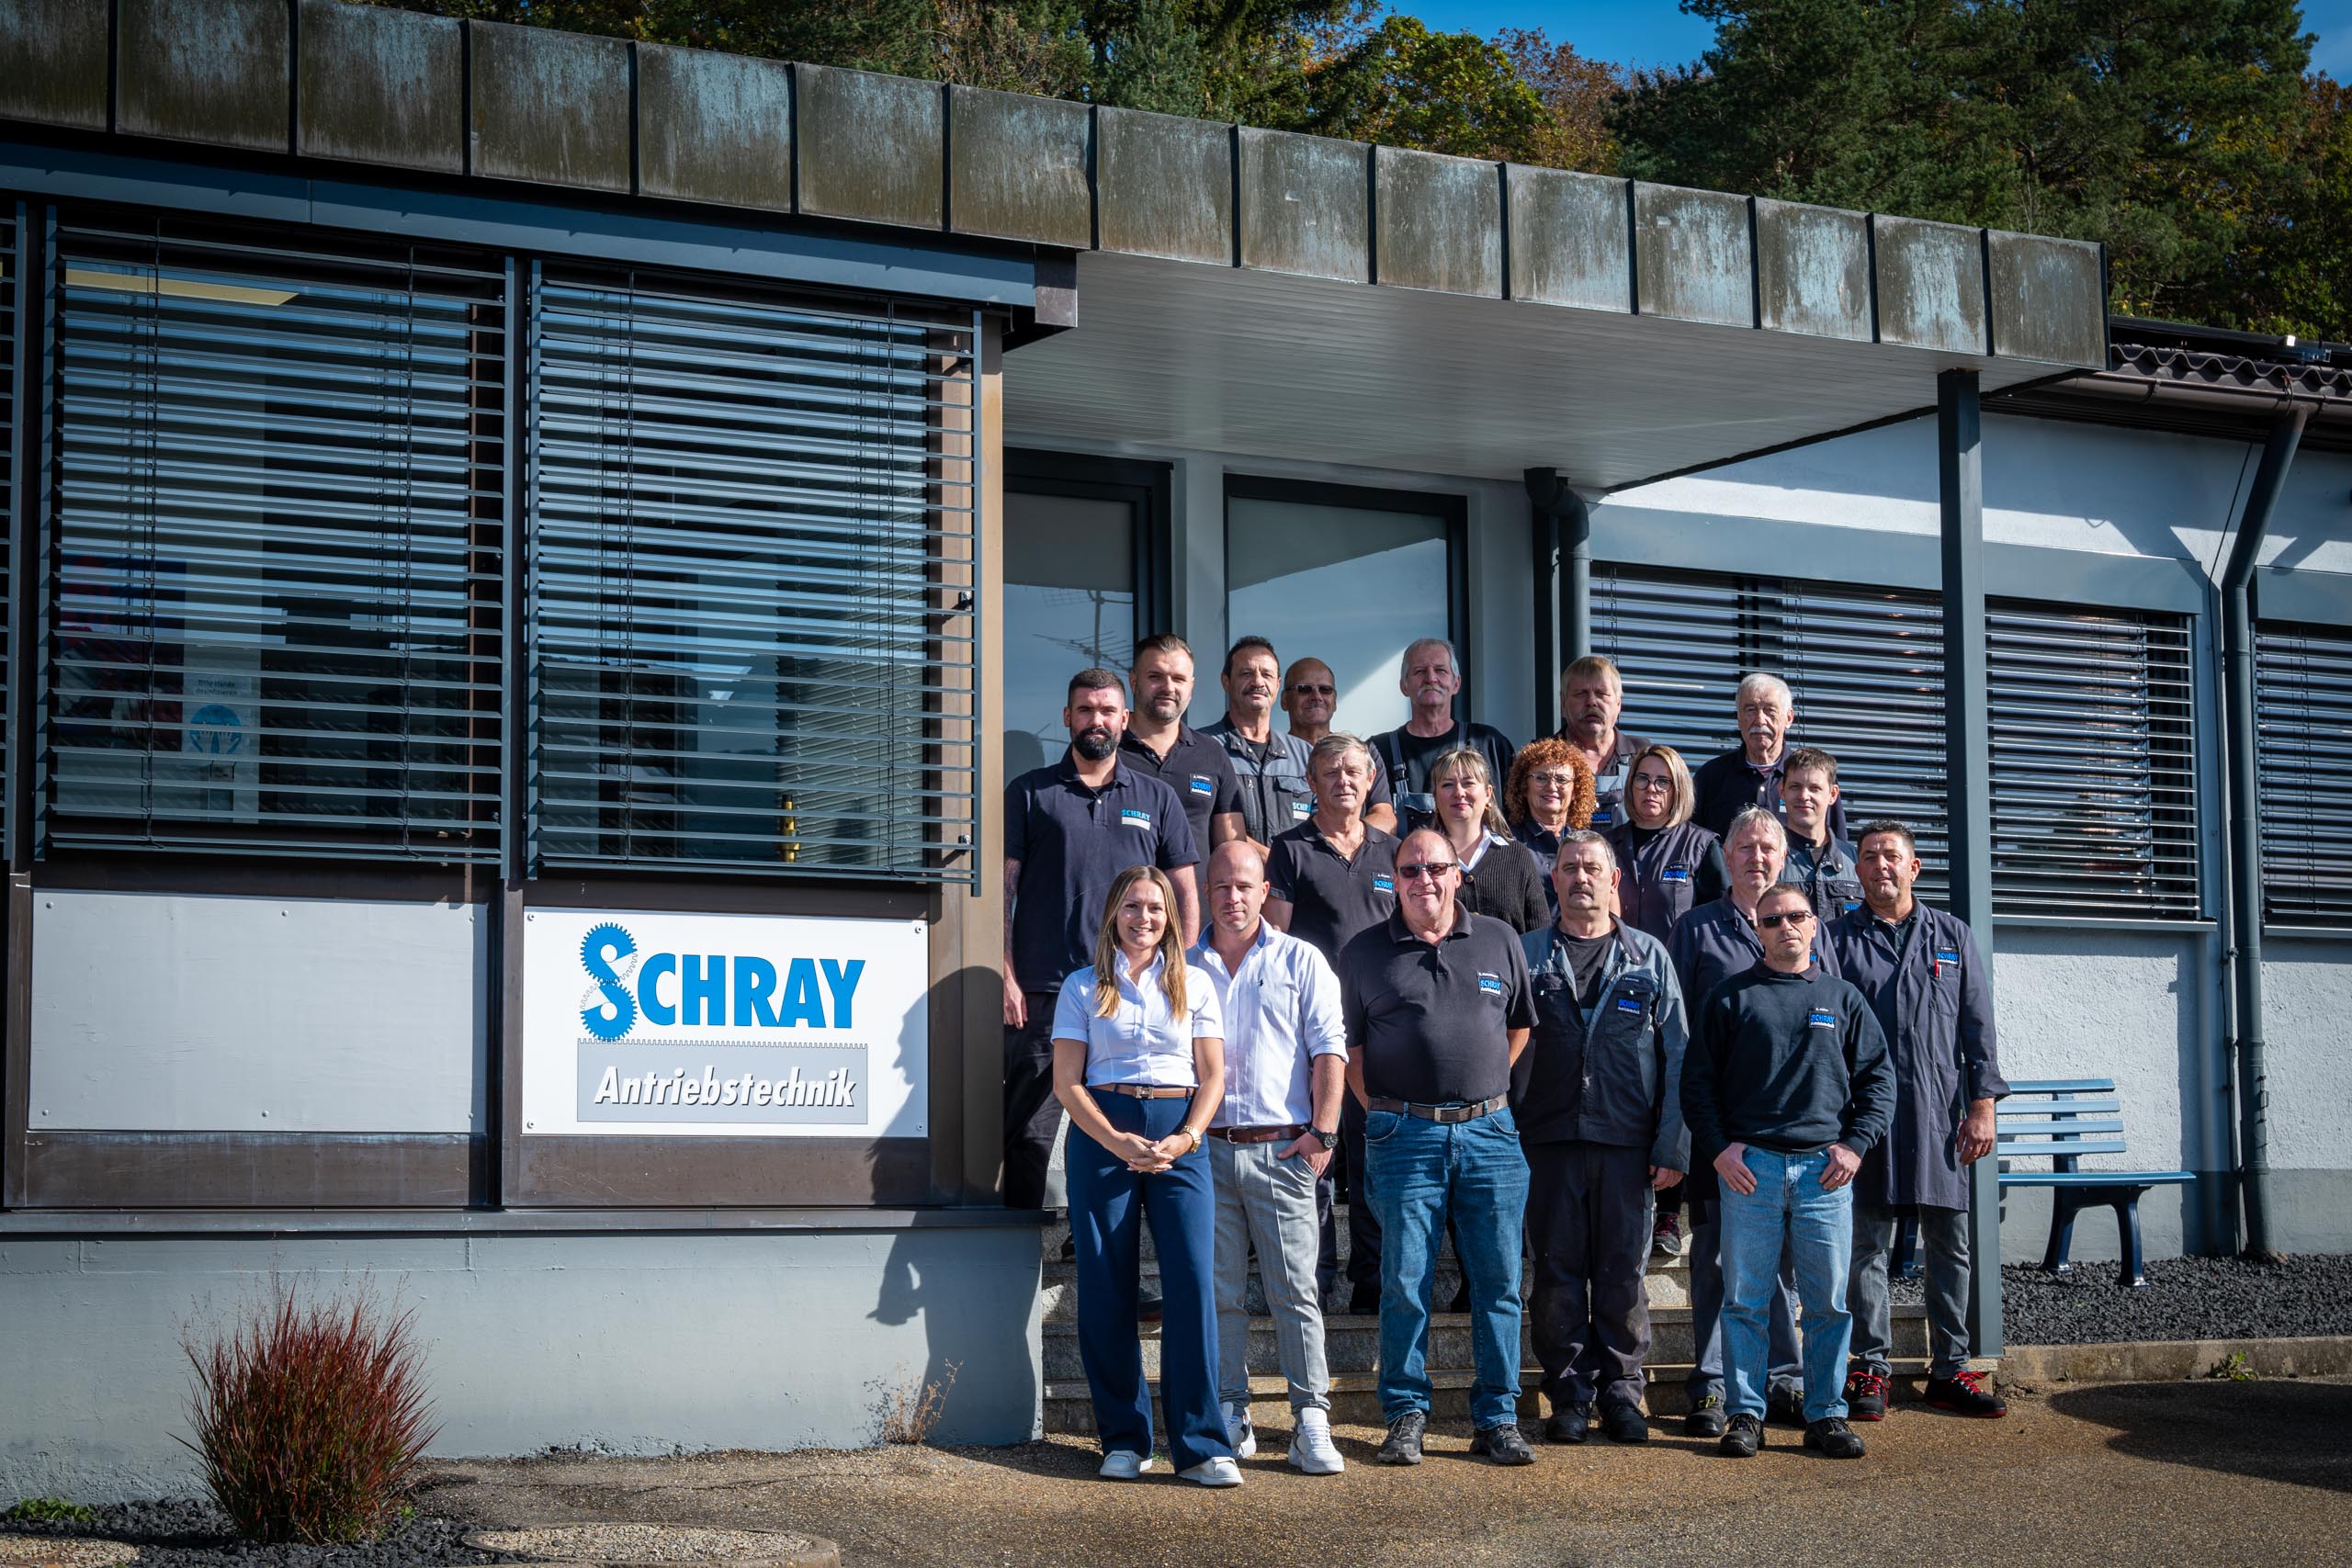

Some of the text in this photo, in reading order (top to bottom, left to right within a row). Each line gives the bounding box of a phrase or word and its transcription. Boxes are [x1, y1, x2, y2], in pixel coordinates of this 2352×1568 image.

[1292, 802, 1311, 813] SCHR
[1121, 808, 1151, 821] SCHRAY
[580, 921, 866, 1042] SCHRAY
[1480, 978, 1501, 990] SCHRAY
[1810, 1013, 1835, 1023] SCHRAY
[594, 1066, 857, 1108] Antriebstechnik
